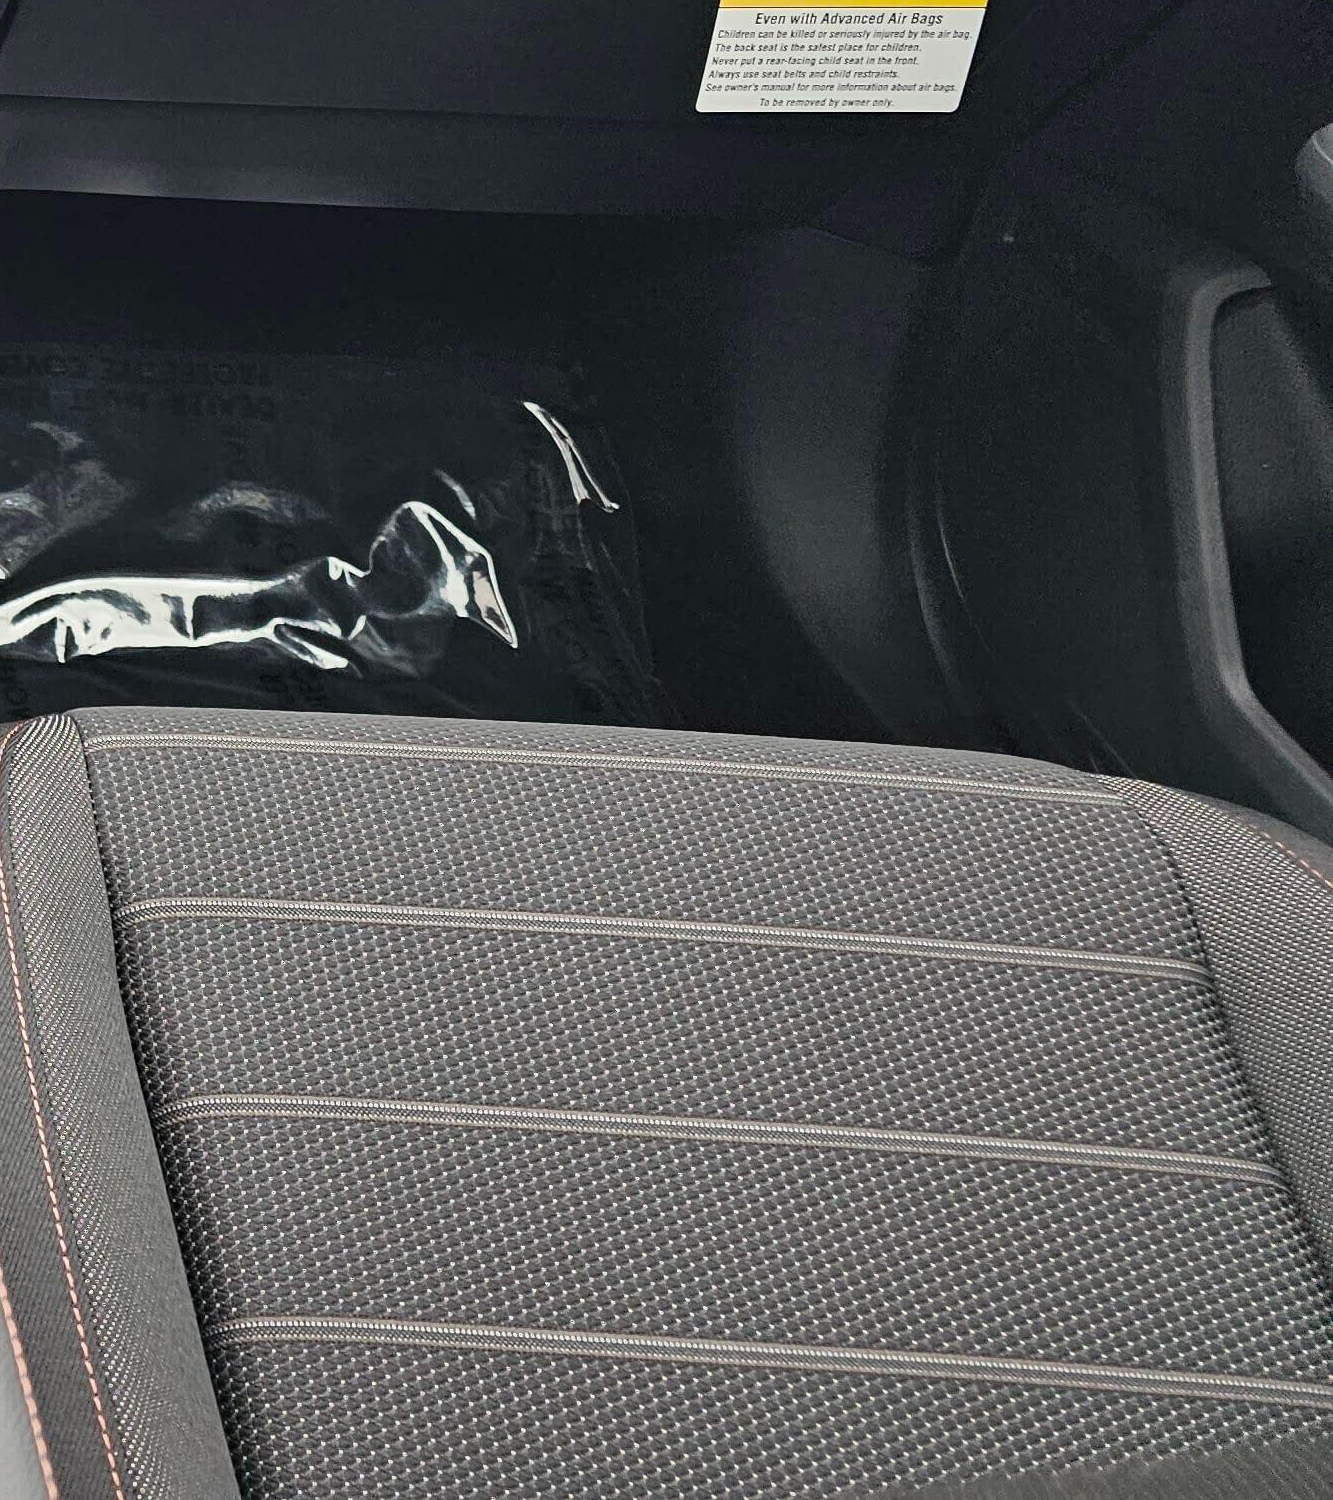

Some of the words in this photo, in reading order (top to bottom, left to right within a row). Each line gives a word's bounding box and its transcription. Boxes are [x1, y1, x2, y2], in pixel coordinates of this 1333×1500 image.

[755, 12, 786, 24] Even
[790, 12, 817, 24] with
[821, 12, 885, 24] Advanced
[887, 12, 907, 24] Air
[911, 12, 944, 26] Bags
[718, 30, 755, 38] Children
[758, 30, 773, 38] can
[776, 30, 787, 38] be
[790, 30, 815, 38] killed
[817, 30, 828, 38] or
[829, 30, 871, 38] seriously
[872, 30, 905, 38] injured
[908, 30, 919, 38] by
[920, 30, 934, 38] the
[937, 30, 951, 38] air
[952, 30, 972, 39] bag.
[715, 44, 731, 52] The
[734, 44, 755, 52] back
[758, 44, 777, 52] seat
[780, 44, 787, 52] is
[791, 44, 805, 52] the
[807, 44, 835, 52] safest
[838, 44, 863, 52] place
[866, 44, 878, 52] for
[881, 44, 922, 52] children.
[711, 57, 738, 65] Never
[740, 57, 755, 66] put
[765, 57, 816, 66] rear-facing
[818, 57, 841, 65] child
[844, 57, 864, 65] seat
[866, 57, 875, 65] in
[877, 57, 892, 65] the
[894, 57, 920, 65] front.
[708, 70, 740, 80] Always
[743, 70, 759, 78] use
[762, 70, 781, 78] seat
[784, 70, 806, 78] belts
[809, 70, 826, 78] and
[828, 70, 851, 78] child
[853, 70, 900, 78] restraints.
[705, 83, 723, 92] See
[724, 83, 759, 92] owner's
[761, 83, 794, 92] manual
[797, 83, 810, 92] for
[837, 83, 888, 92] information
[890, 83, 916, 92] about
[918, 83, 931, 92] air
[933, 83, 958, 92] bags.
[760, 98, 769, 106] To
[772, 98, 783, 106] be
[786, 98, 826, 106] removed
[829, 98, 839, 108] by
[842, 98, 870, 106] owner
[872, 98, 895, 107] only.
